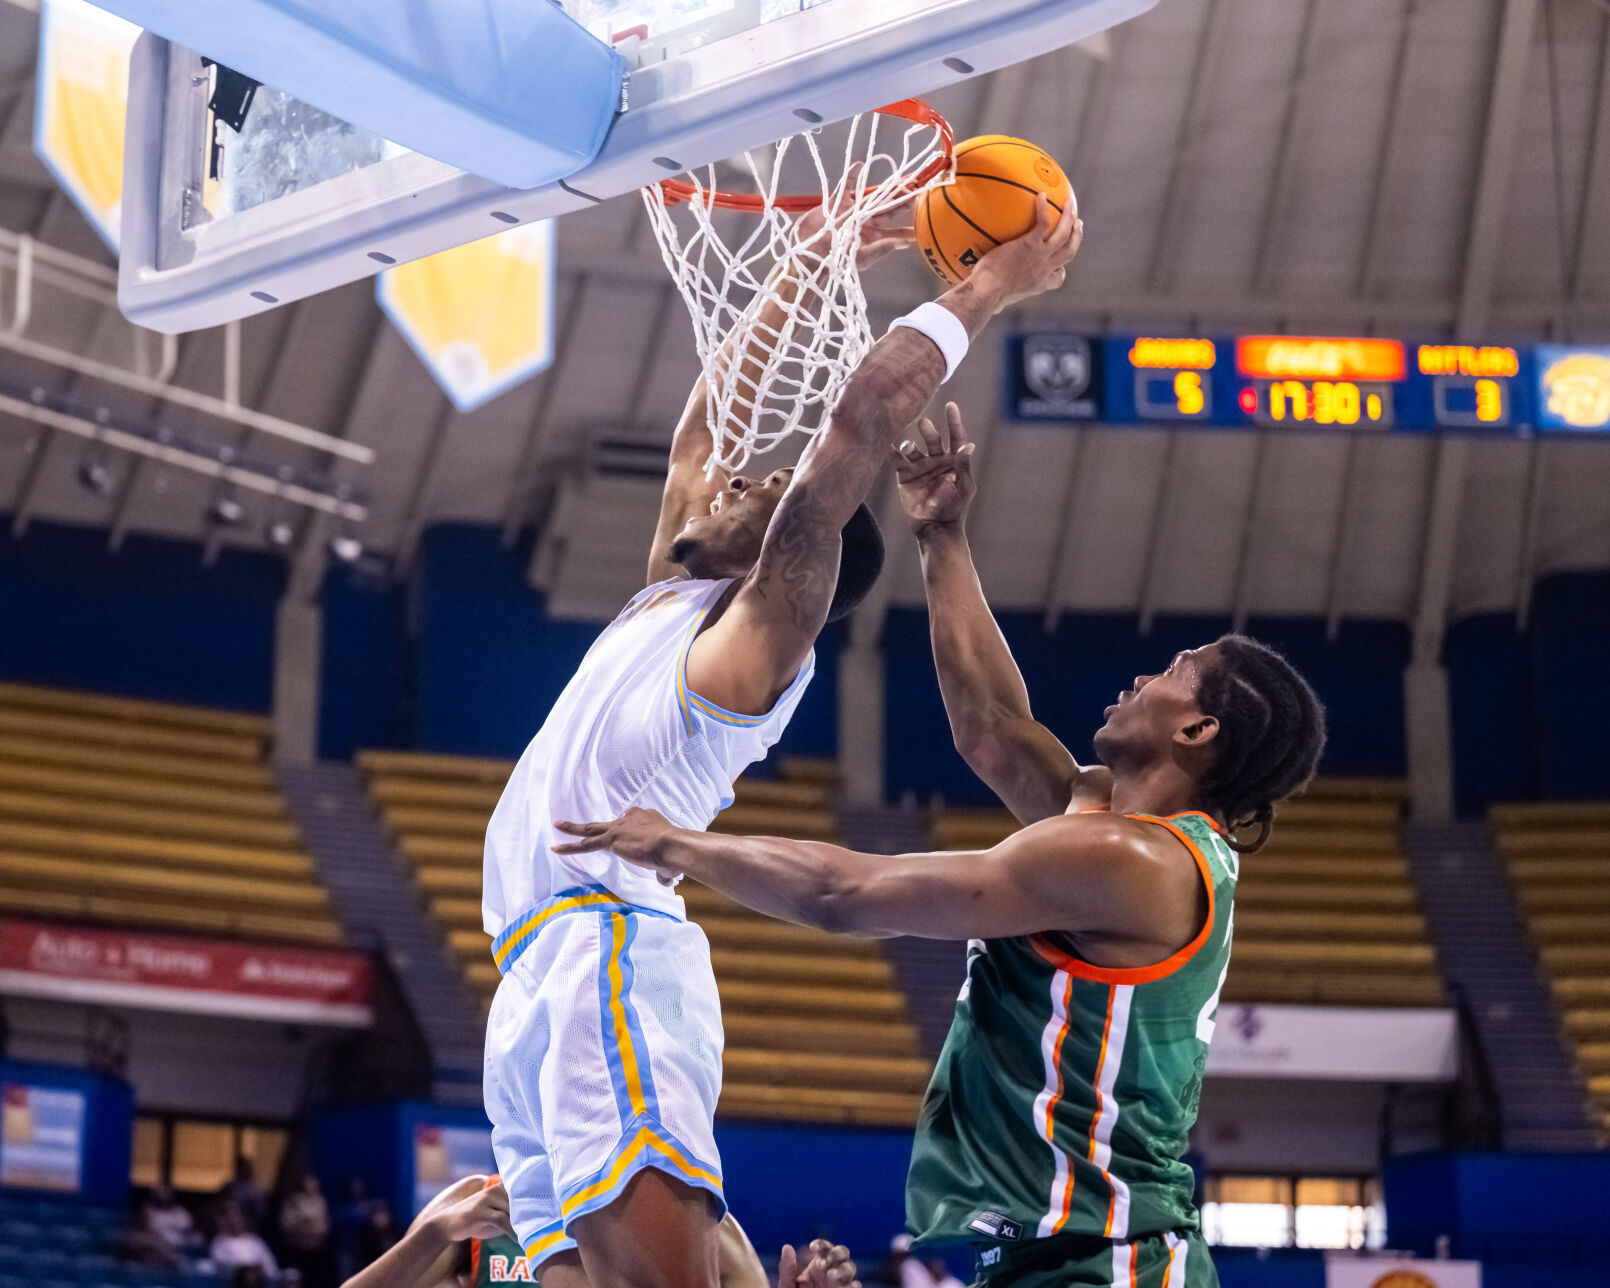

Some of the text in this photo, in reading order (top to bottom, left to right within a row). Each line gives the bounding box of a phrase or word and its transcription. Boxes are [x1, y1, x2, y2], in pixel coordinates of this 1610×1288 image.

[1174, 371, 1204, 414] 5
[1475, 379, 1501, 422] 3
[1001, 1224, 1017, 1238] XL
